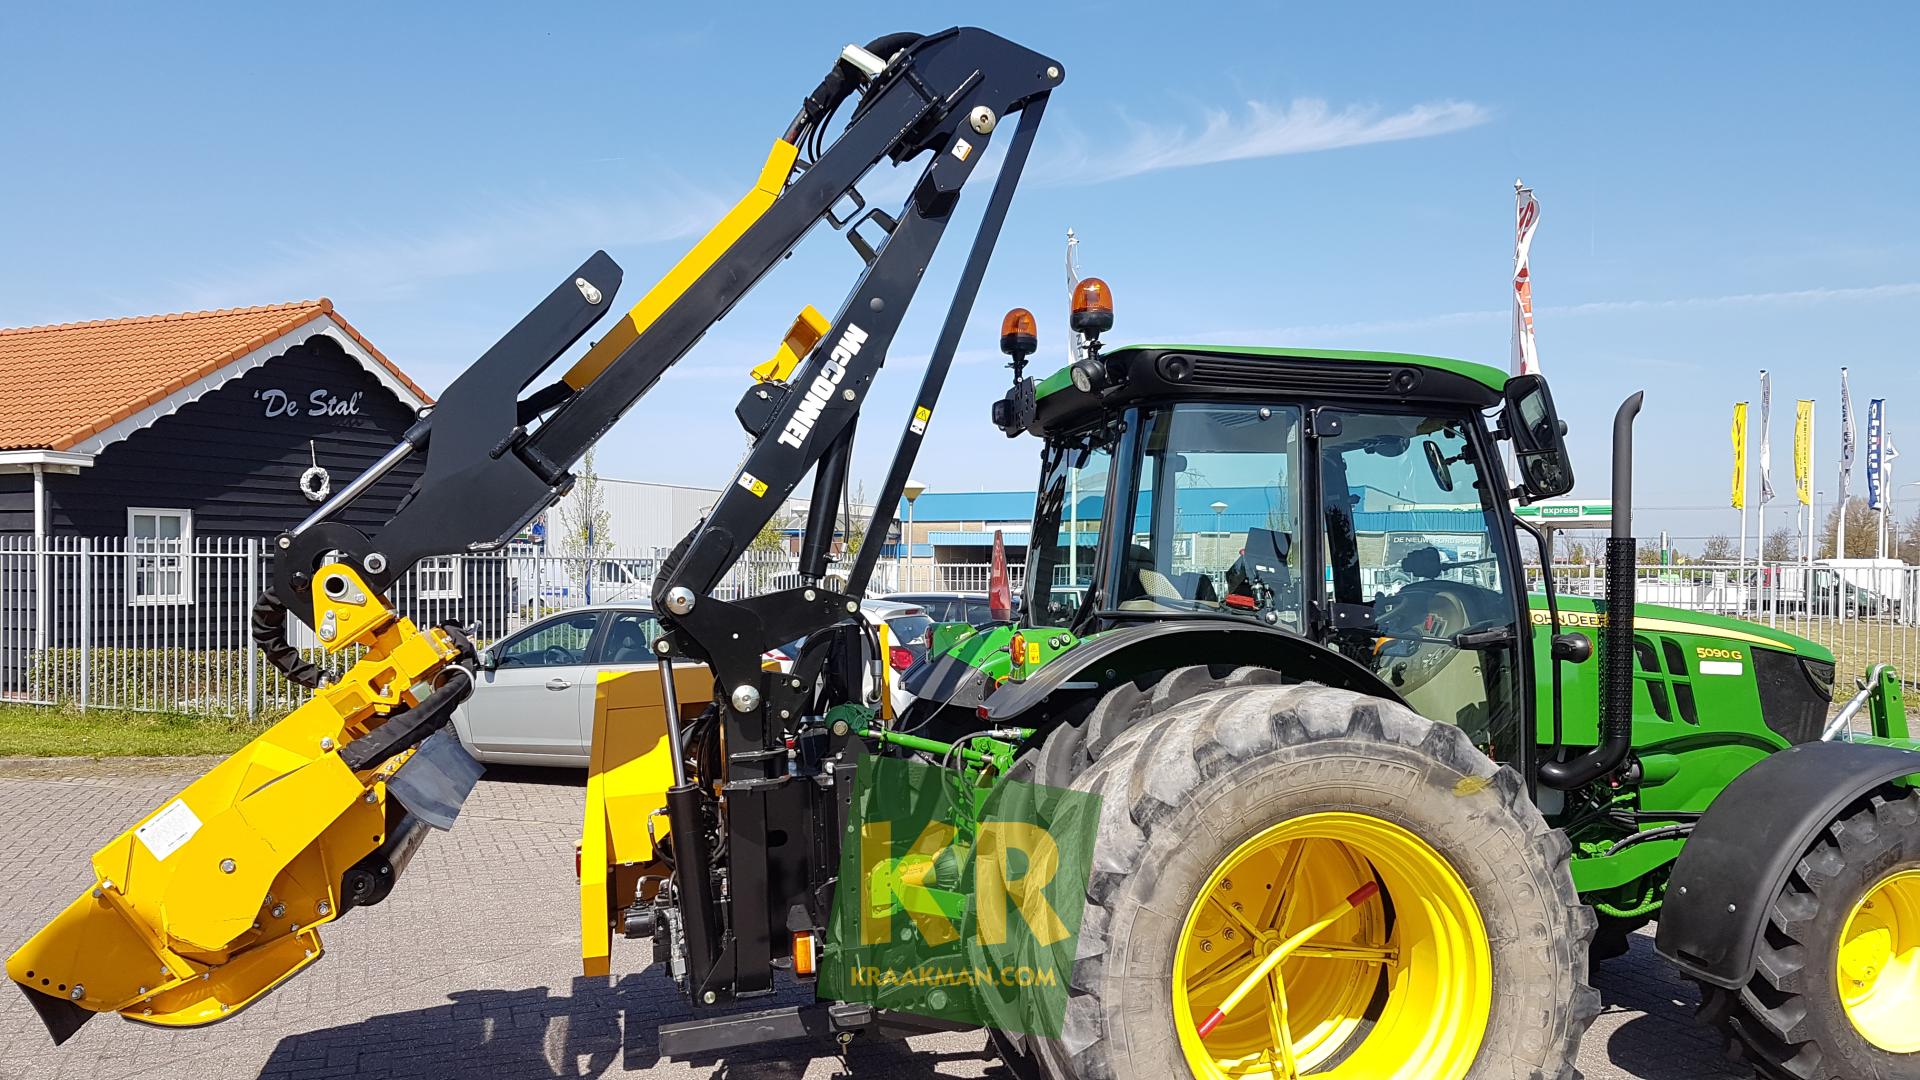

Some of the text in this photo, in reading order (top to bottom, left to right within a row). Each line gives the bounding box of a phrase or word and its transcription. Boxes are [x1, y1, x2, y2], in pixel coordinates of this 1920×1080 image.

[1543, 507, 1579, 516] express
[1696, 647, 1743, 660] 5090 G
